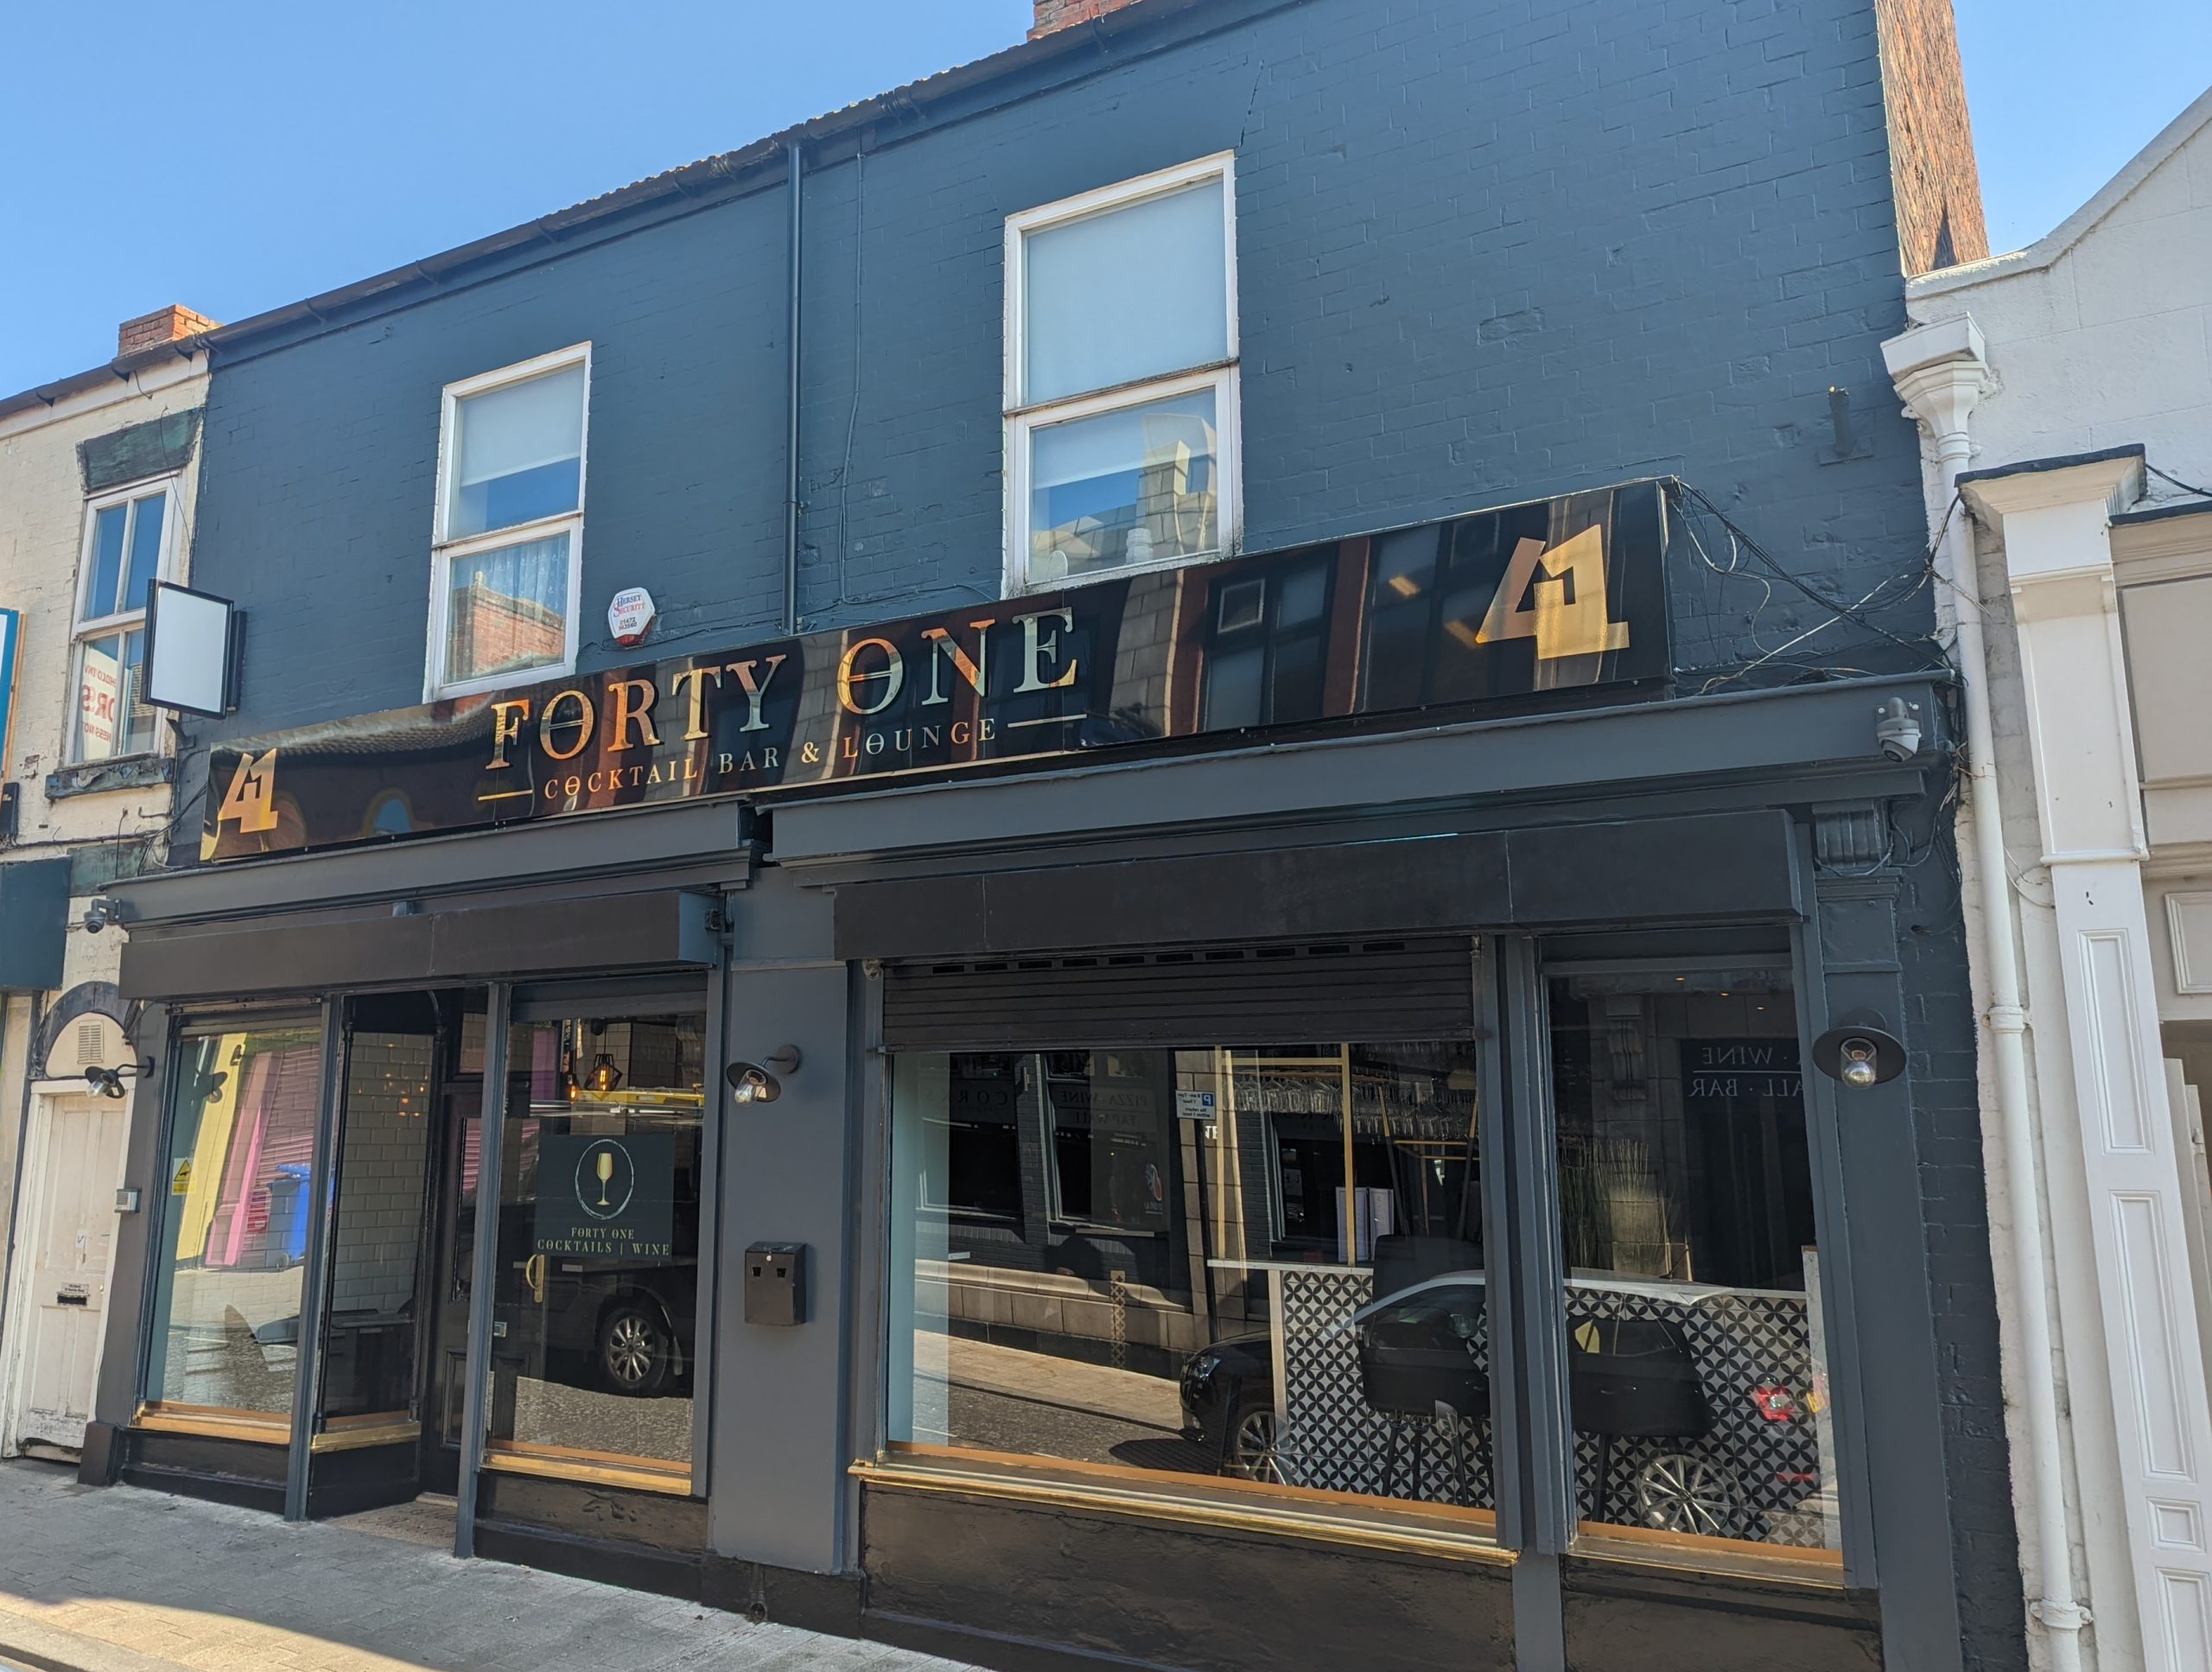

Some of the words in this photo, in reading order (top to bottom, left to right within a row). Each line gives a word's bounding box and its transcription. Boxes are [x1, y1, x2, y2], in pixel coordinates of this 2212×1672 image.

[1475, 524, 1630, 660] 41
[486, 654, 787, 770] FORTY
[836, 607, 1077, 715] ONE
[218, 747, 278, 834] 41
[544, 759, 697, 800] COCKTAIL
[718, 747, 779, 774] BAR
[801, 741, 820, 764] &
[843, 718, 995, 759] LOUNGE
[537, 1239, 612, 1253] COCKTAILS
[632, 1243, 670, 1256] WINE
[571, 1227, 607, 1239] FORTY
[612, 1229, 634, 1240] ONE
